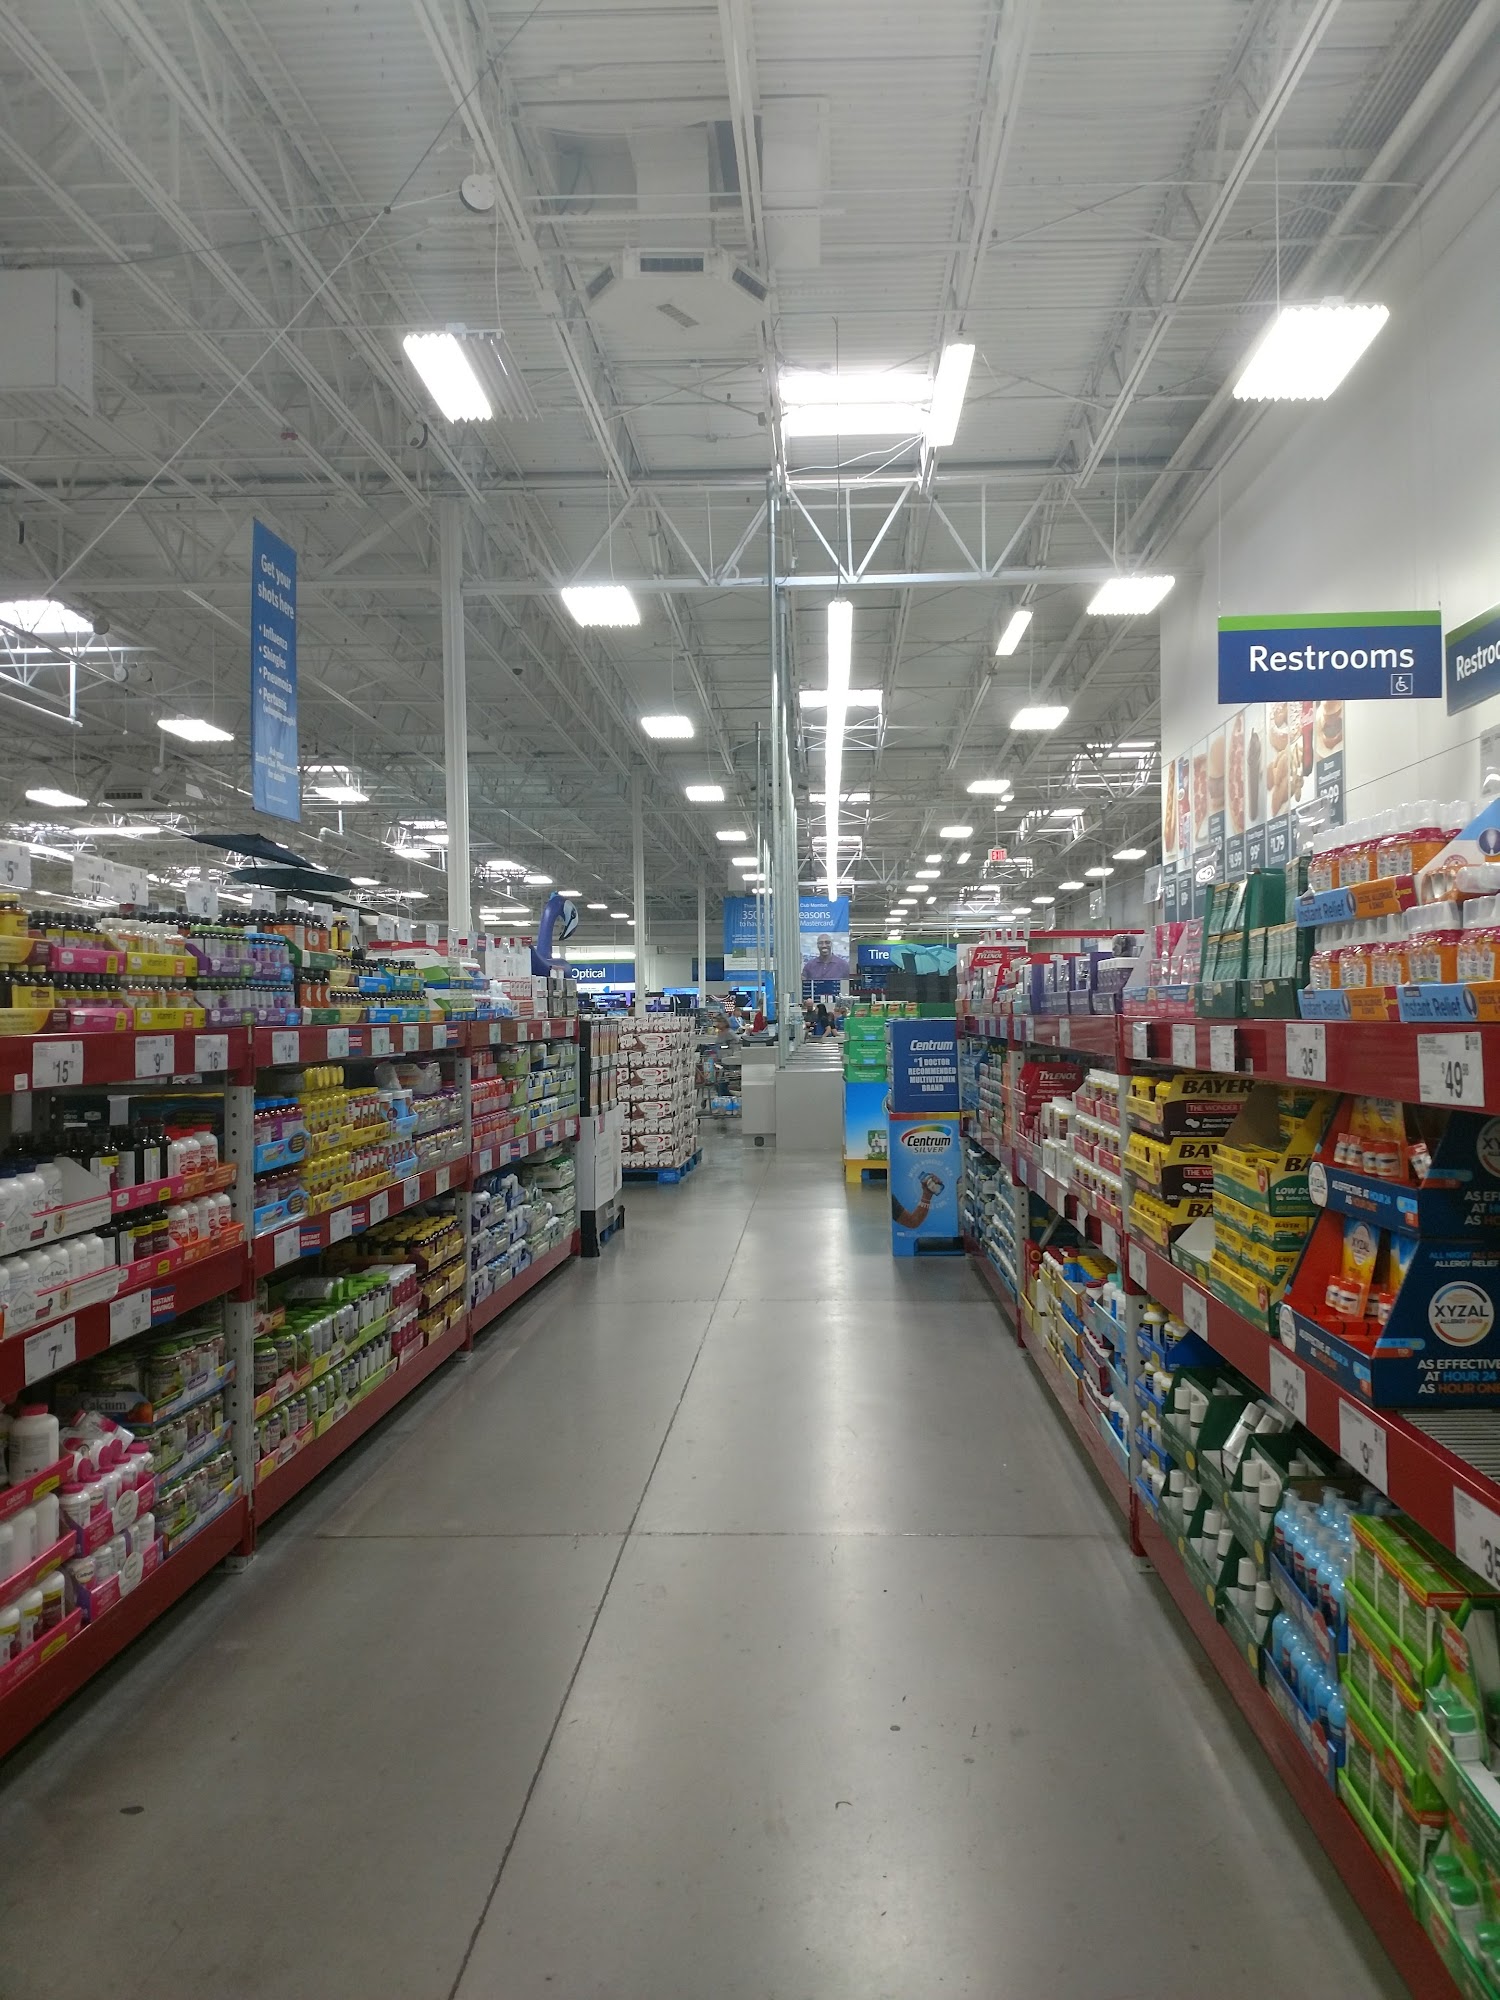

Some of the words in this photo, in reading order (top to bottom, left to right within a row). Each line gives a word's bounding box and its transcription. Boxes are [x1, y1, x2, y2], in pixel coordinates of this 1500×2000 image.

[260, 554, 275, 578] Get
[276, 568, 291, 590] your
[257, 581, 279, 608] shots
[280, 593, 294, 619] here
[263, 624, 287, 650] Influenza
[263, 645, 286, 670] Shingles
[1250, 645, 1414, 672] Restrooms
[263, 666, 292, 694] Pneumonia
[991, 850, 1005, 861] EXIT
[799, 911, 830, 919] easons
[1323, 902, 1345, 918] Relief
[868, 949, 889, 959] Tire
[571, 967, 606, 980] Optical
[1434, 999, 1461, 1017] Relief
[910, 1040, 954, 1051] Centrum
[923, 1058, 950, 1066] DOCTOR
[908, 1067, 957, 1075] RECOMMENDED
[1039, 1070, 1076, 1080] TYLENOL
[910, 1075, 956, 1084] MULTIVITAMIN
[921, 1084, 944, 1092] BRAND
[1181, 1079, 1256, 1094] BAYER
[1205, 1103, 1238, 1111] WONDER
[907, 1136, 951, 1147] Centrum
[1275, 1187, 1296, 1195] LOW
[1464, 1191, 1480, 1201] AS
[1471, 1203, 1486, 1213] AT
[1464, 1216, 1481, 1225] AS
[152, 1295, 174, 1306] INSTANT
[152, 1302, 174, 1313] SAVINGS
[1434, 1305, 1489, 1318] XYZAL
[1417, 1359, 1435, 1369] AS
[1436, 1359, 1500, 1369] EFFECTIVE
[1424, 1371, 1440, 1381] AT
[1443, 1371, 1480, 1382] HOUR
[1482, 1371, 1497, 1381] 24
[1418, 1384, 1435, 1394] AS
[1438, 1383, 1474, 1393] HOUR
